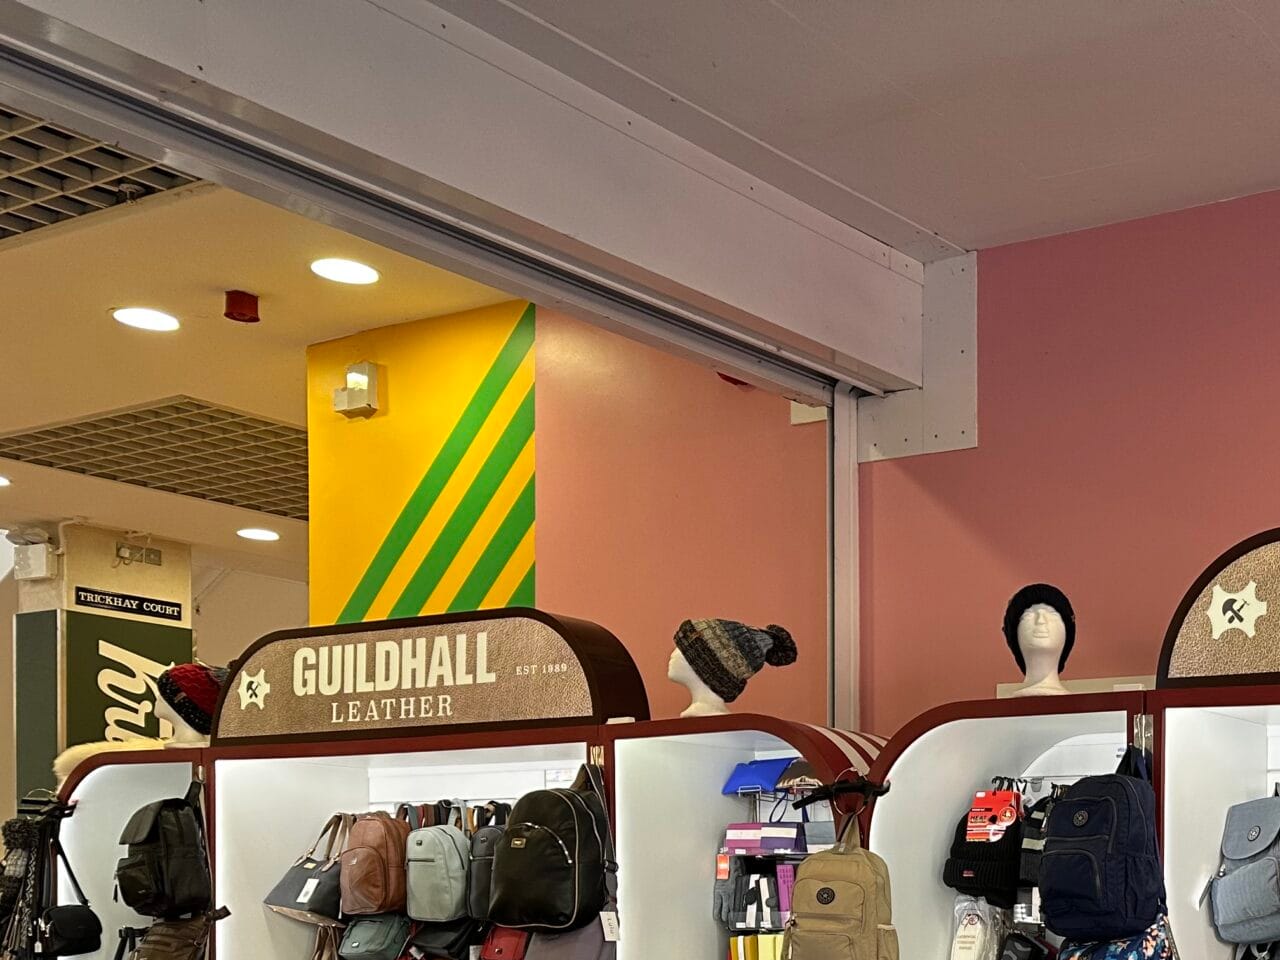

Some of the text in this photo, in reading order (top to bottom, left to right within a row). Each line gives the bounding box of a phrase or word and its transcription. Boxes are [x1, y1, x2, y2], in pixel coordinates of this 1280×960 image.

[78, 591, 180, 616] TRICKHAY COURT
[293, 632, 496, 696] GUILDHALL
[516, 665, 539, 676] EST
[331, 694, 453, 723] LEATHER
